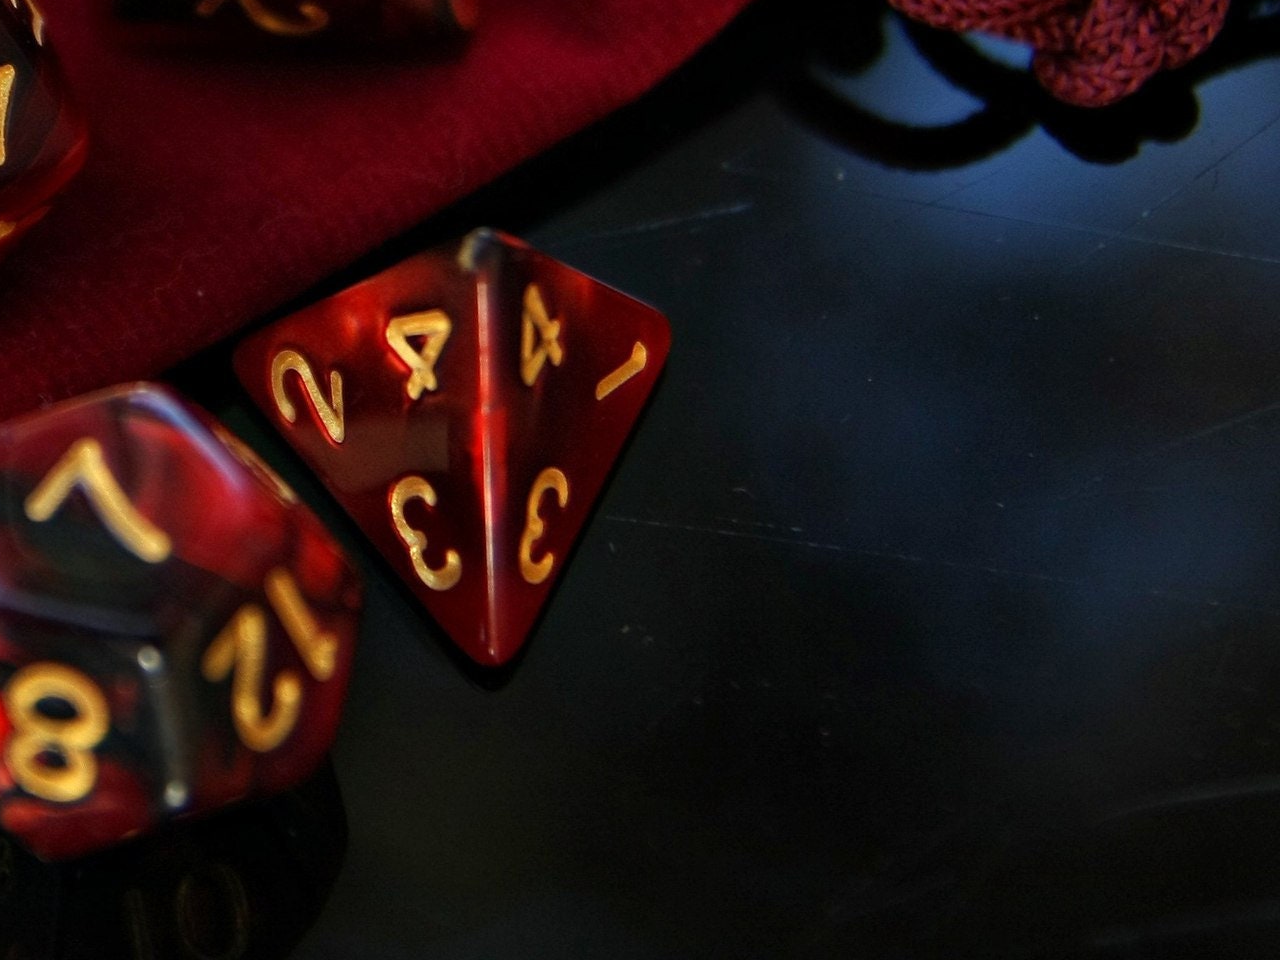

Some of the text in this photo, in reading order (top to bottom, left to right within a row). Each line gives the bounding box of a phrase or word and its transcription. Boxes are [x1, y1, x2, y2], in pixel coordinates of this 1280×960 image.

[386, 308, 451, 400] 4
[522, 283, 563, 386] 4
[595, 340, 647, 400] 1
[271, 349, 344, 443] 2
[25, 439, 172, 564] 7
[391, 475, 462, 591] 3
[522, 467, 569, 584] 3
[201, 568, 337, 751] 12
[4, 661, 110, 803] 8
